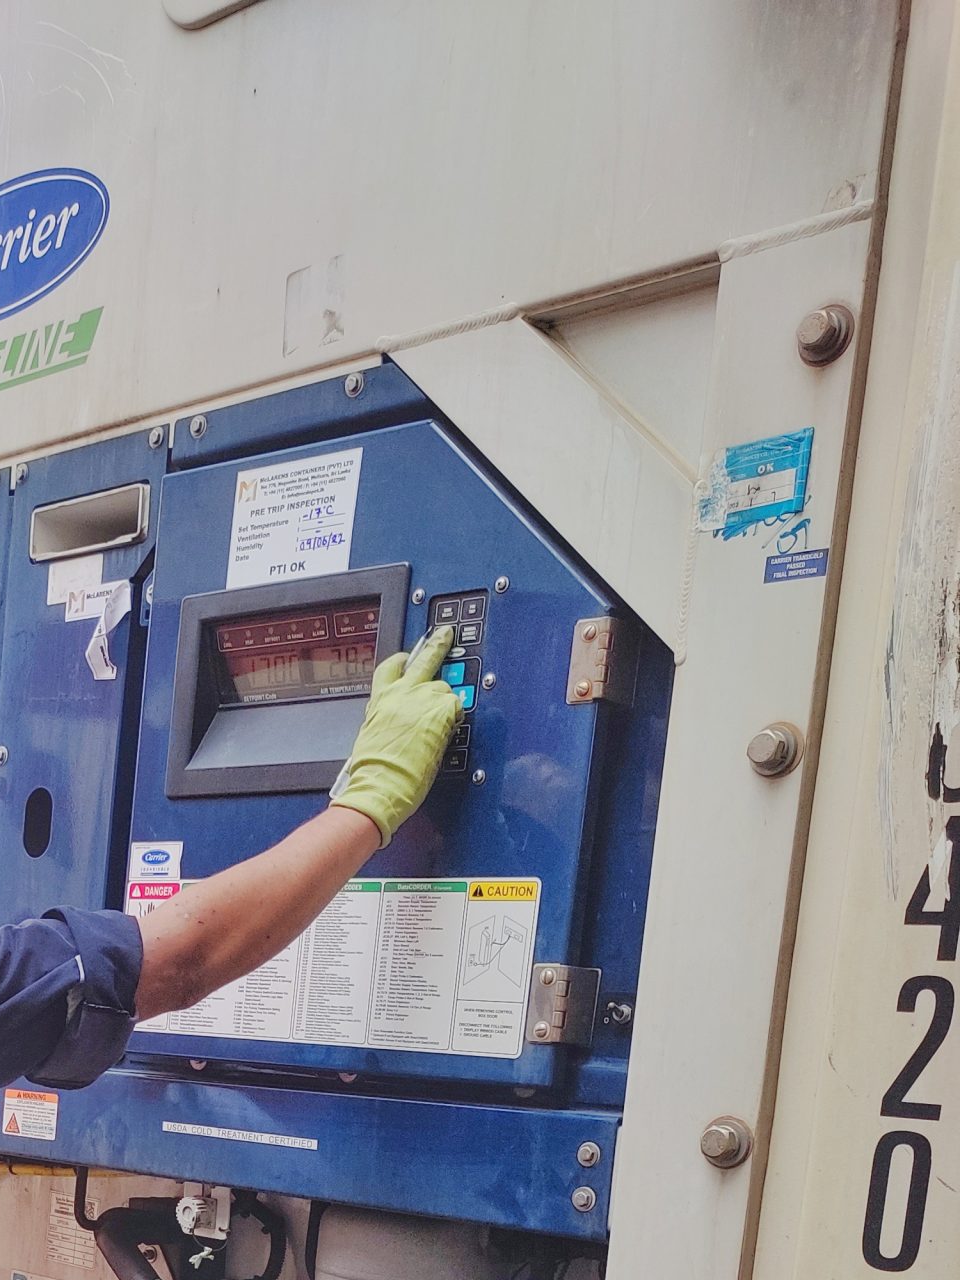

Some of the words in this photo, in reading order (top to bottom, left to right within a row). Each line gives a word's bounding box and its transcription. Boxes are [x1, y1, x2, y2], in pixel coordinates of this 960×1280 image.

[290, 465, 326, 478] CONTAINERS
[757, 463, 774, 474] OK
[250, 508, 266, 518] PRE
[268, 504, 285, 515] TRIP
[287, 495, 336, 511] INSPECTION
[238, 525, 249, 534] Set
[250, 519, 289, 533] Temperature
[237, 532, 271, 543] Ventilation
[236, 542, 264, 553] Humidity
[235, 554, 250, 562] Date
[269, 564, 287, 576] PTI
[290, 560, 307, 573] OK
[144, 886, 174, 897] DANGER
[487, 885, 534, 897] CAUTION
[166, 1123, 188, 1133] USDA
[191, 1126, 212, 1136] COLD
[217, 1129, 264, 1142] TREATMENT
[268, 1135, 314, 1148] CERTIFIED
